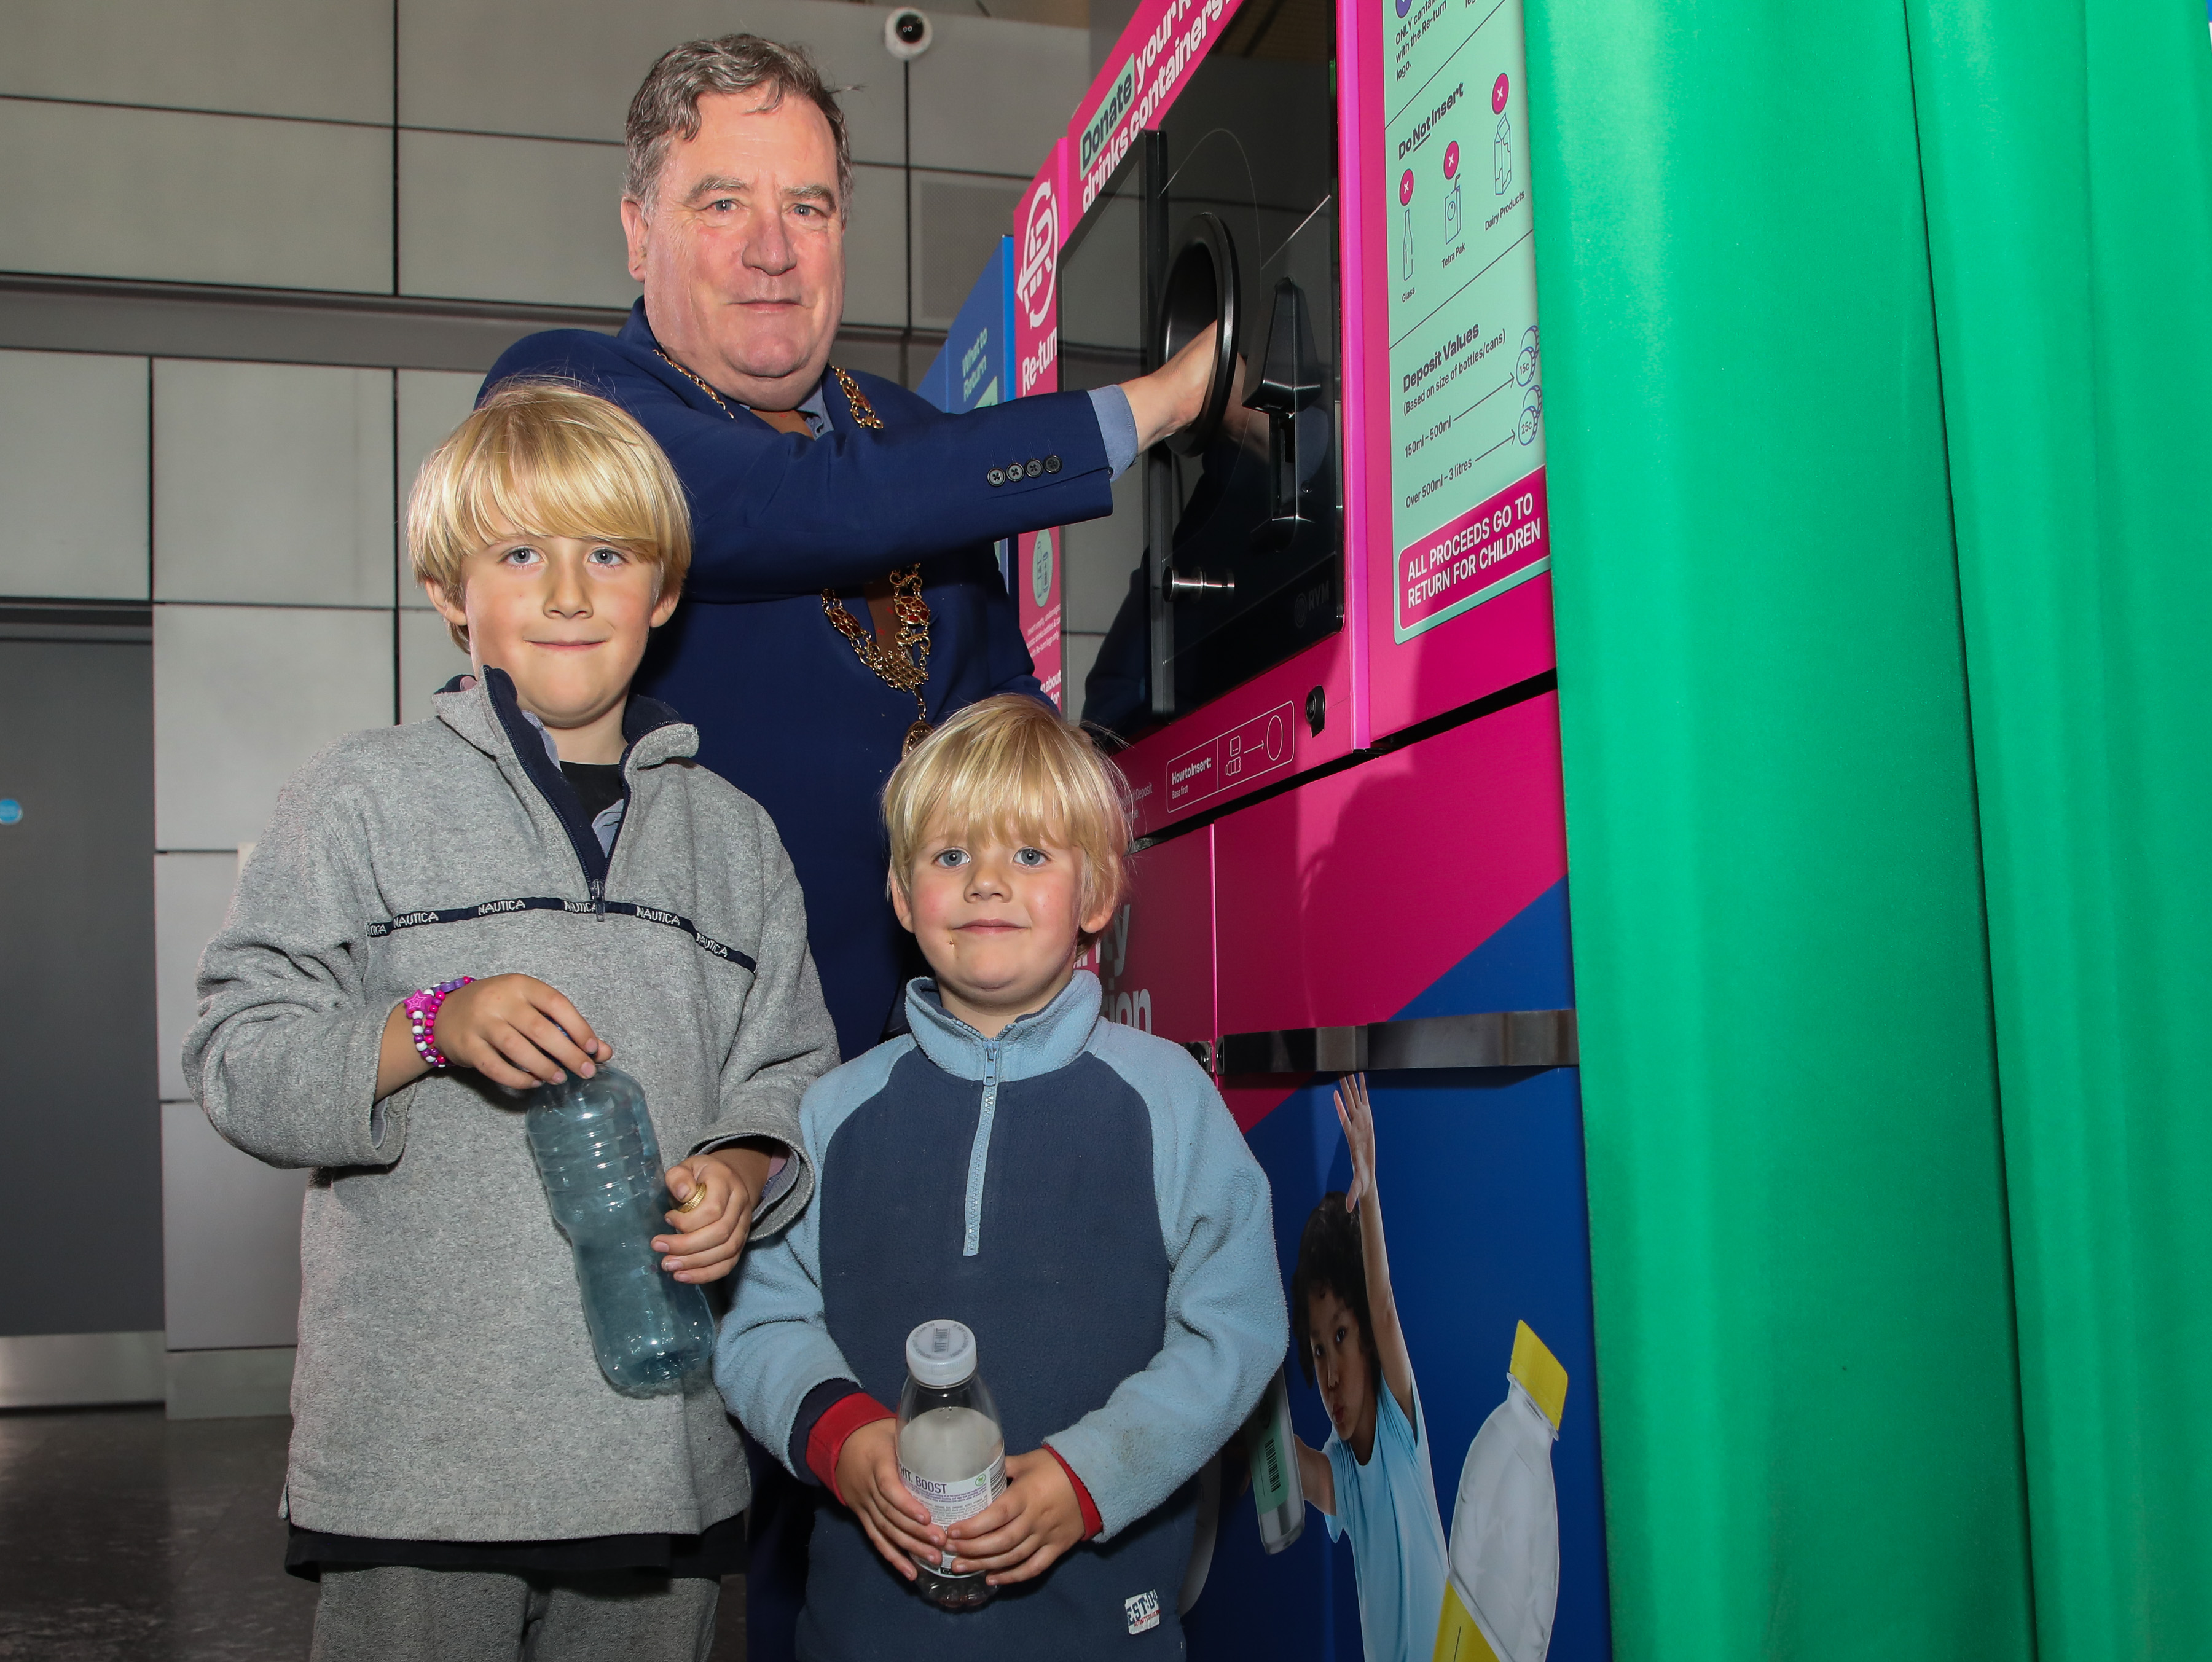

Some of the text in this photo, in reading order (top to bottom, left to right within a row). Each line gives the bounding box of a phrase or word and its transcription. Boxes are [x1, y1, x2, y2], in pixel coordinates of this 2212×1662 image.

[1395, 17, 1413, 45] ONLY
[1396, 0, 1446, 63] with the Re-turn
[1083, 1, 1177, 170] Donate your
[1396, 60, 1412, 82] logo.
[1398, 82, 1464, 160] Do Not Insert
[1083, 127, 1128, 214] drinks
[1485, 191, 1525, 231] Dairy Products
[1441, 242, 1465, 269] Tetra Pak
[1402, 287, 1415, 303] Glass
[1022, 326, 1057, 397] Re-turn
[1403, 324, 1479, 393] Deposit Values
[1404, 328, 1506, 416] (Based on size of bottles/cans)
[1520, 363, 1529, 375] 15c
[1405, 434, 1424, 458] 150ml
[1430, 415, 1451, 441] 500ml
[1521, 421, 1532, 435] 25c
[1406, 491, 1421, 508] Over
[1422, 474, 1443, 498] 500ml
[1449, 468, 1454, 480] 3
[1454, 458, 1472, 477] litres
[1408, 492, 1533, 582] ALL PROCEEDS GO TO
[1408, 517, 1541, 609] RETURN FOR CHILDREN
[1308, 580, 1329, 611] RVM
[1172, 757, 1212, 785] How to Insert:
[1172, 790, 1180, 799] Base
[369, 924, 387, 935] TICA
[393, 912, 439, 928] NAUTICA
[477, 900, 525, 916] NAUTICA
[637, 906, 681, 926] NAUTICA
[916, 1476, 947, 1494] BOOST
